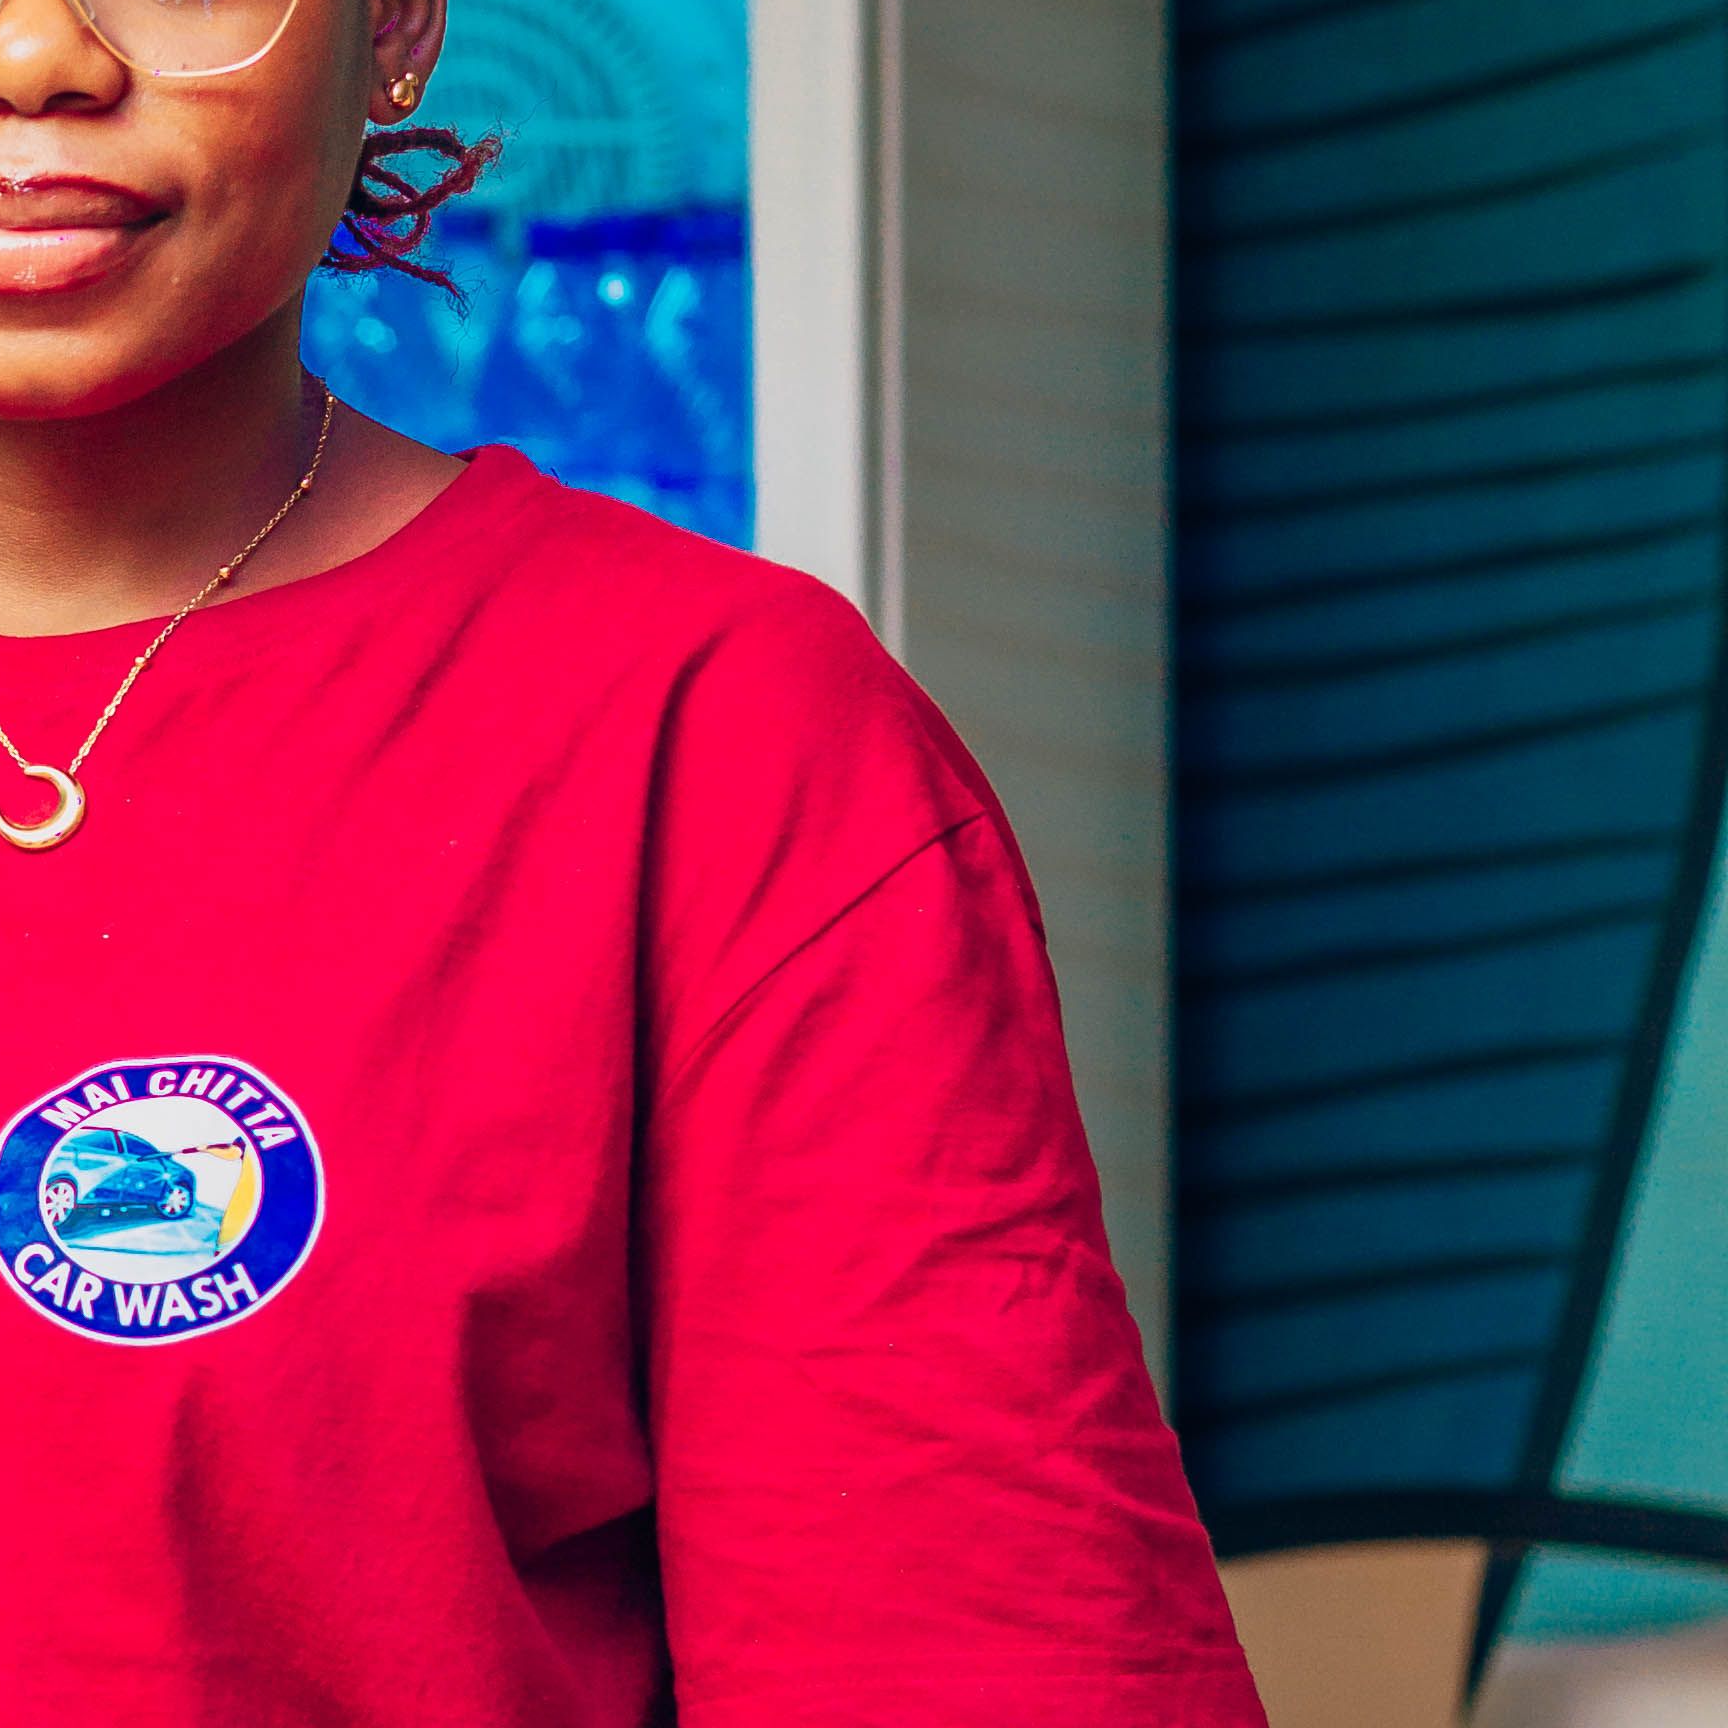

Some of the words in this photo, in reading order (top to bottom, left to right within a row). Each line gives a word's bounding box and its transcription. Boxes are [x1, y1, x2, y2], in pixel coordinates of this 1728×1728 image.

[40, 1075, 132, 1131] MAI
[148, 1067, 297, 1151] CHITTA
[14, 1243, 103, 1320] CAR
[113, 1263, 259, 1327] WASH
